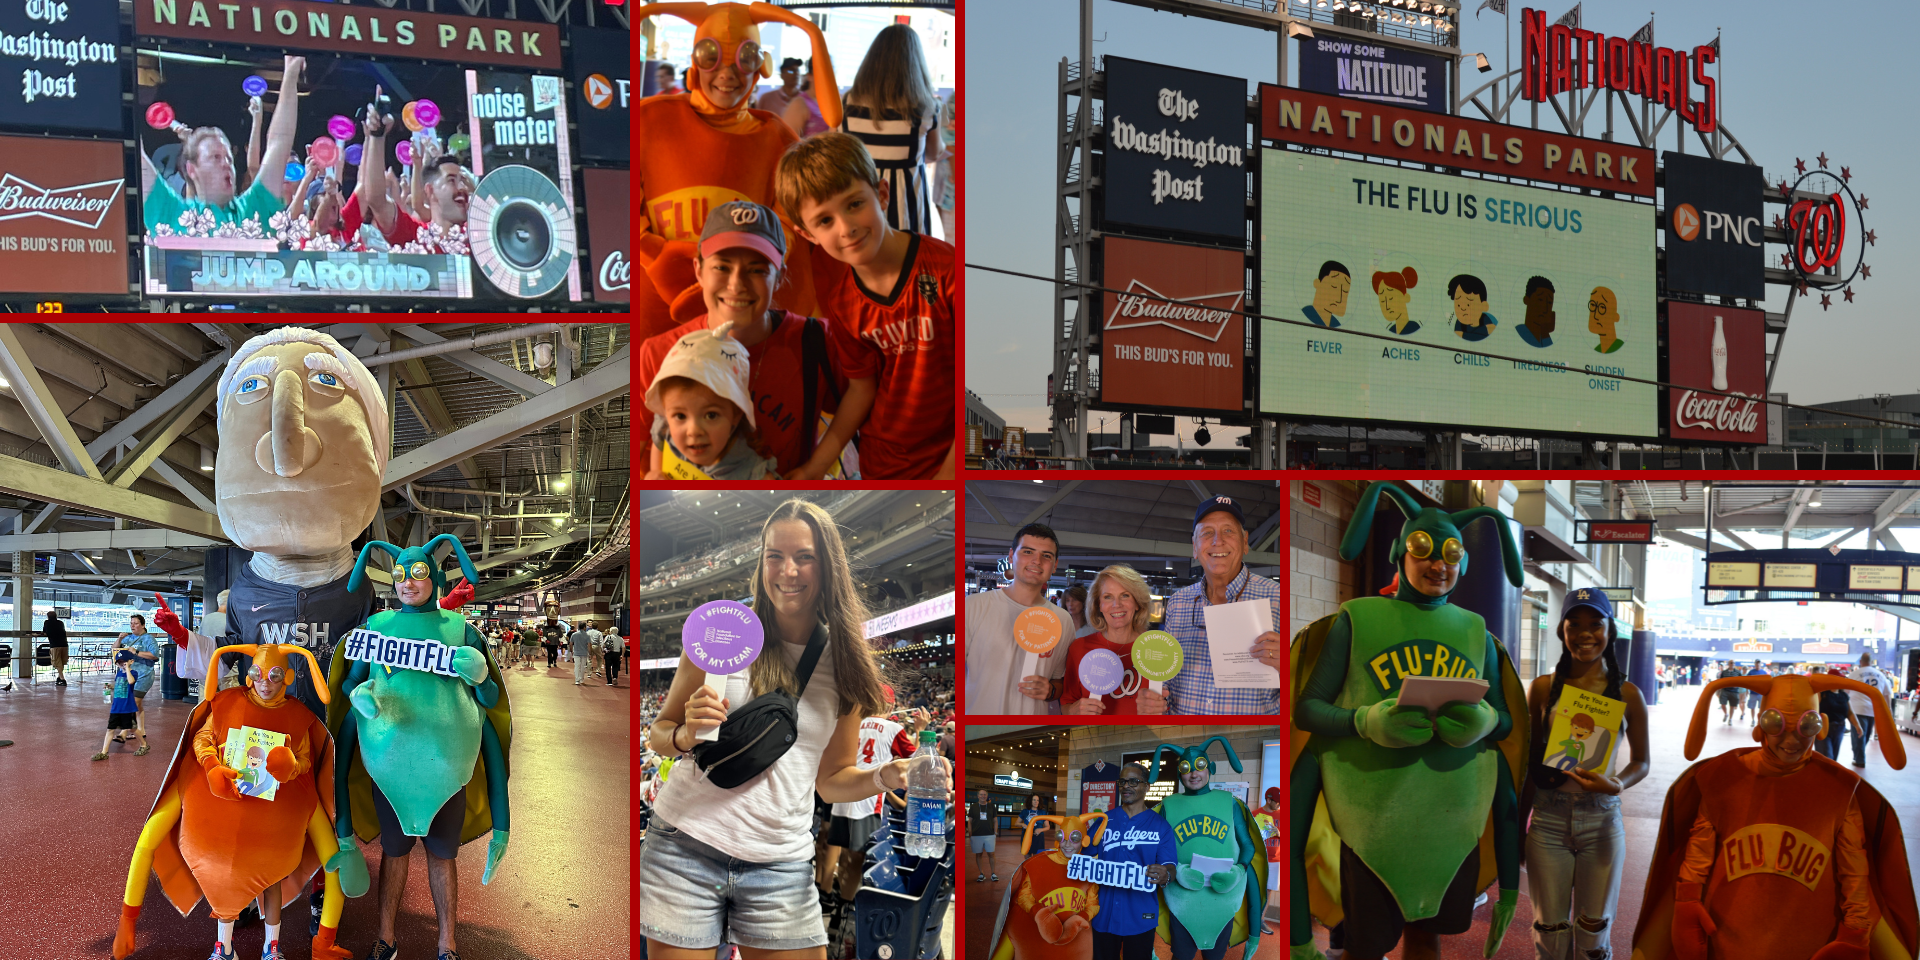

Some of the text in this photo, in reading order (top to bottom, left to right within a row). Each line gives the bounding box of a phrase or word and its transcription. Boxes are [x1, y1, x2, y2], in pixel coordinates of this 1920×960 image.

[26, 0, 68, 24] The
[153, 0, 542, 56] NATIONALS PARK
[1317, 40, 1385, 58] SHOW SOME
[1336, 57, 1428, 99] NATITUDE
[1521, 7, 1716, 133] NATIONALS
[22, 68, 77, 103] Post
[472, 87, 526, 118] noise
[1157, 88, 1199, 122] The
[494, 117, 556, 146] meter
[1110, 115, 1243, 168] Washington
[1279, 99, 1638, 183] NATIONALS PARK
[1151, 168, 1204, 205] Post
[653, 197, 708, 240] FLU
[1352, 178, 1583, 233] THE FLU IS SERIOUS
[1703, 210, 1762, 247] PNC
[21, 237, 59, 252] BUD'S
[61, 238, 85, 252] FOR
[88, 239, 117, 253] YOU.
[191, 255, 431, 291] JUMP AROUND
[1116, 292, 1232, 325] Budweiser
[1114, 344, 1234, 368] THIS BUD'S FOR YOU.
[1306, 340, 1343, 355] FEVER
[1382, 346, 1421, 361] ACHES
[1454, 353, 1490, 367] CHILLS
[1513, 359, 1567, 374] TIREDNESS
[1584, 364, 1625, 378] SUDDEN
[1588, 378, 1621, 392] ONSET
[1676, 389, 1764, 433] Coca-Cola
[674, 463, 689, 479] Are
[1611, 531, 1646, 539] Escalator
[1651, 549, 1689, 563] HVAC
[1577, 588, 1590, 600] LA
[58, 609, 69, 618] 109
[706, 606, 752, 625] #FIGHTFLU
[261, 622, 330, 648] WSH
[691, 642, 754, 668] FOR MY TEAM
[1573, 701, 1610, 716] Flu Fighter?
[1579, 693, 1591, 702] Are
[1592, 697, 1603, 706] You
[860, 721, 884, 734] ARINO
[858, 738, 876, 764] 4
[1089, 782, 1116, 790] DIRECTORY
[1174, 816, 1228, 843] FLU-BUG
[1726, 831, 1826, 885] FLU BUG
